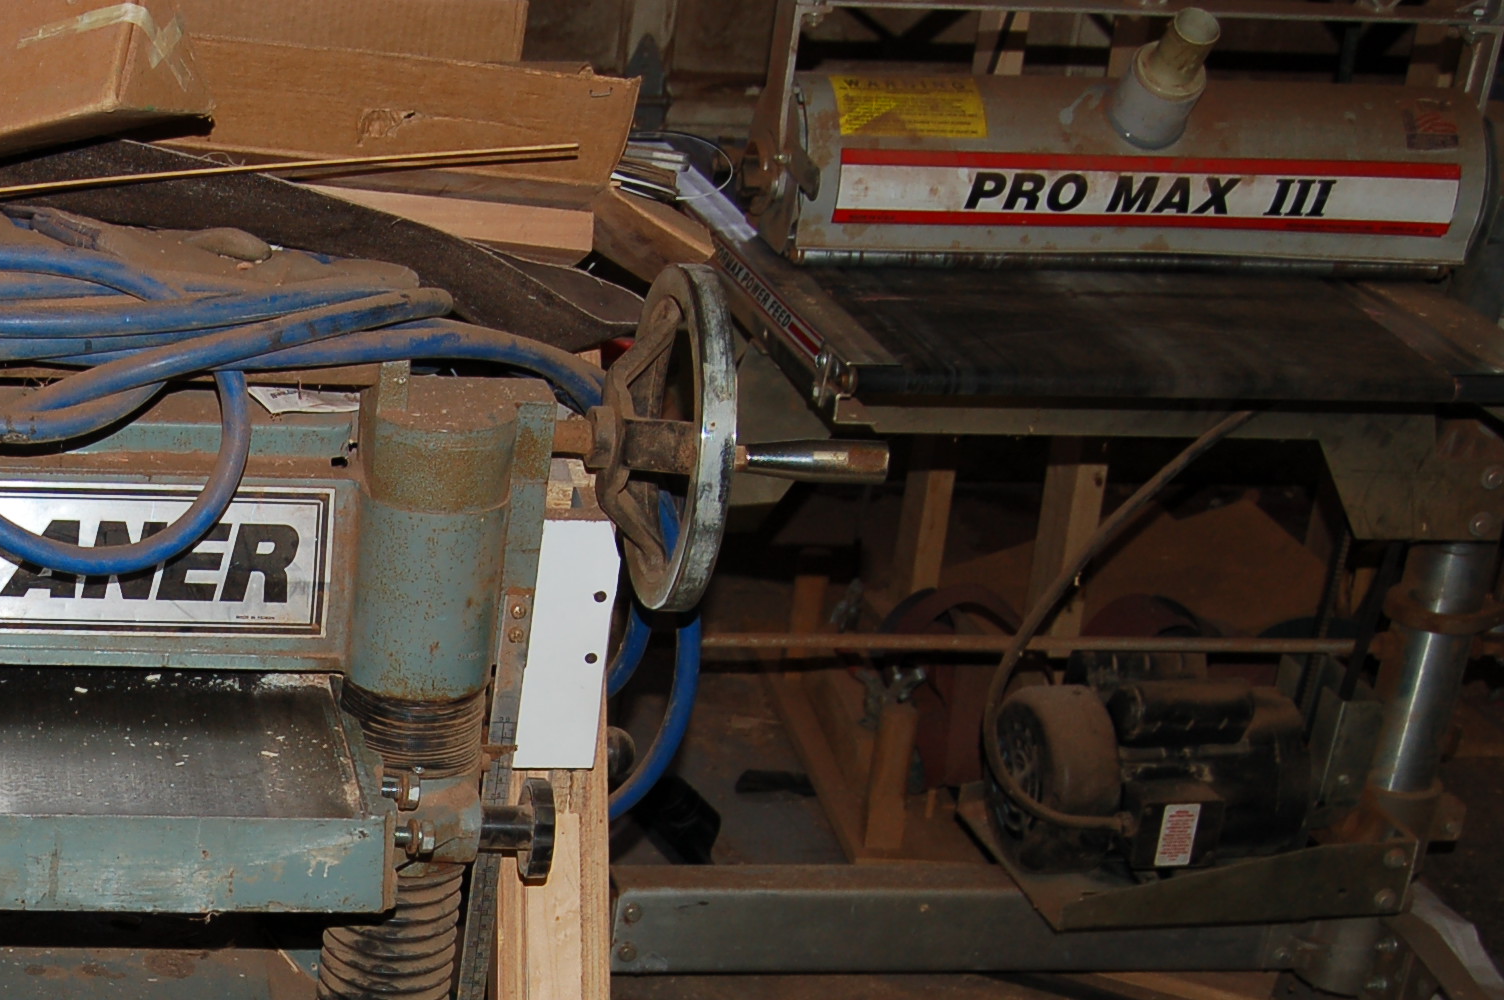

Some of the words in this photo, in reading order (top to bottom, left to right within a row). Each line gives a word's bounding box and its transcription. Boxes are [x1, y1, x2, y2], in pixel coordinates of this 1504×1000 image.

[964, 172, 1088, 213] PRO
[1106, 175, 1242, 218] MAX
[1262, 178, 1338, 219] III
[740, 271, 772, 306] POWER
[767, 300, 793, 328] FEED
